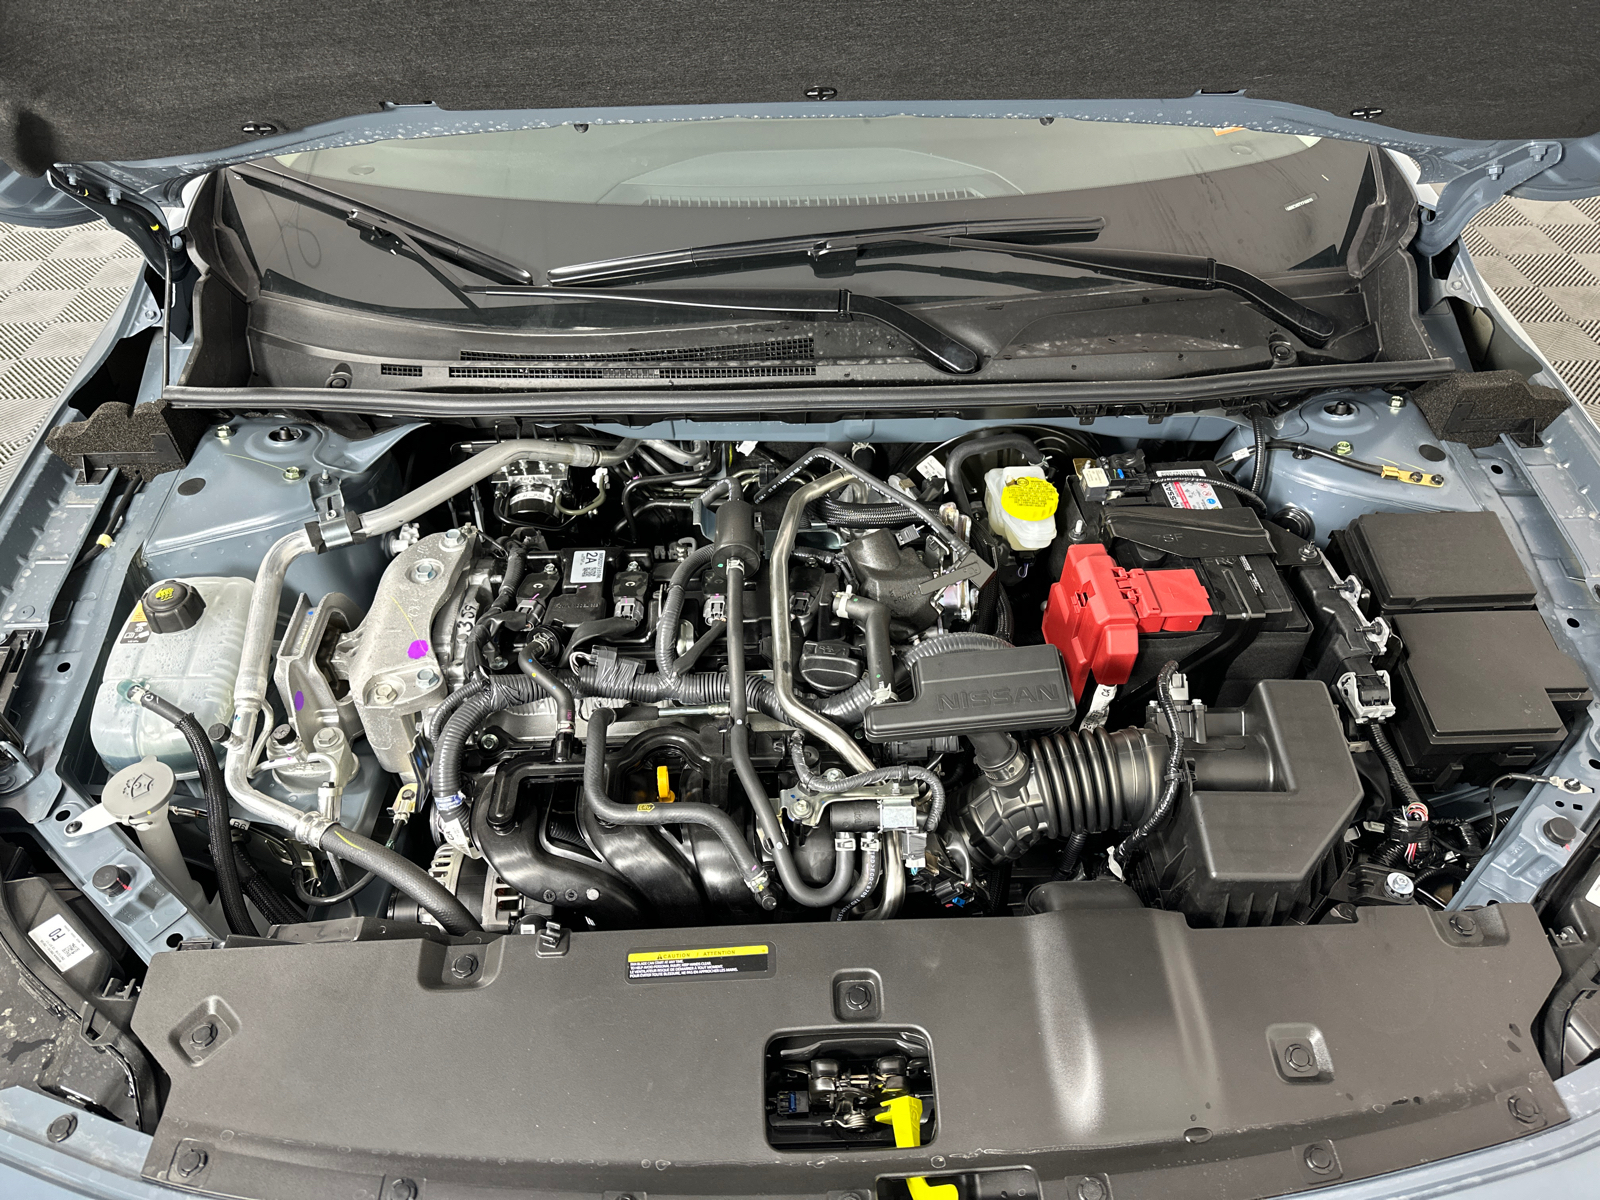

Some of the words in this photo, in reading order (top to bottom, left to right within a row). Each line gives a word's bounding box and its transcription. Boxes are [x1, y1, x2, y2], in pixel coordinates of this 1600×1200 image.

[1163, 481, 1180, 508] NISSAN
[585, 552, 598, 564] 2A
[936, 684, 1060, 711] NISSAN
